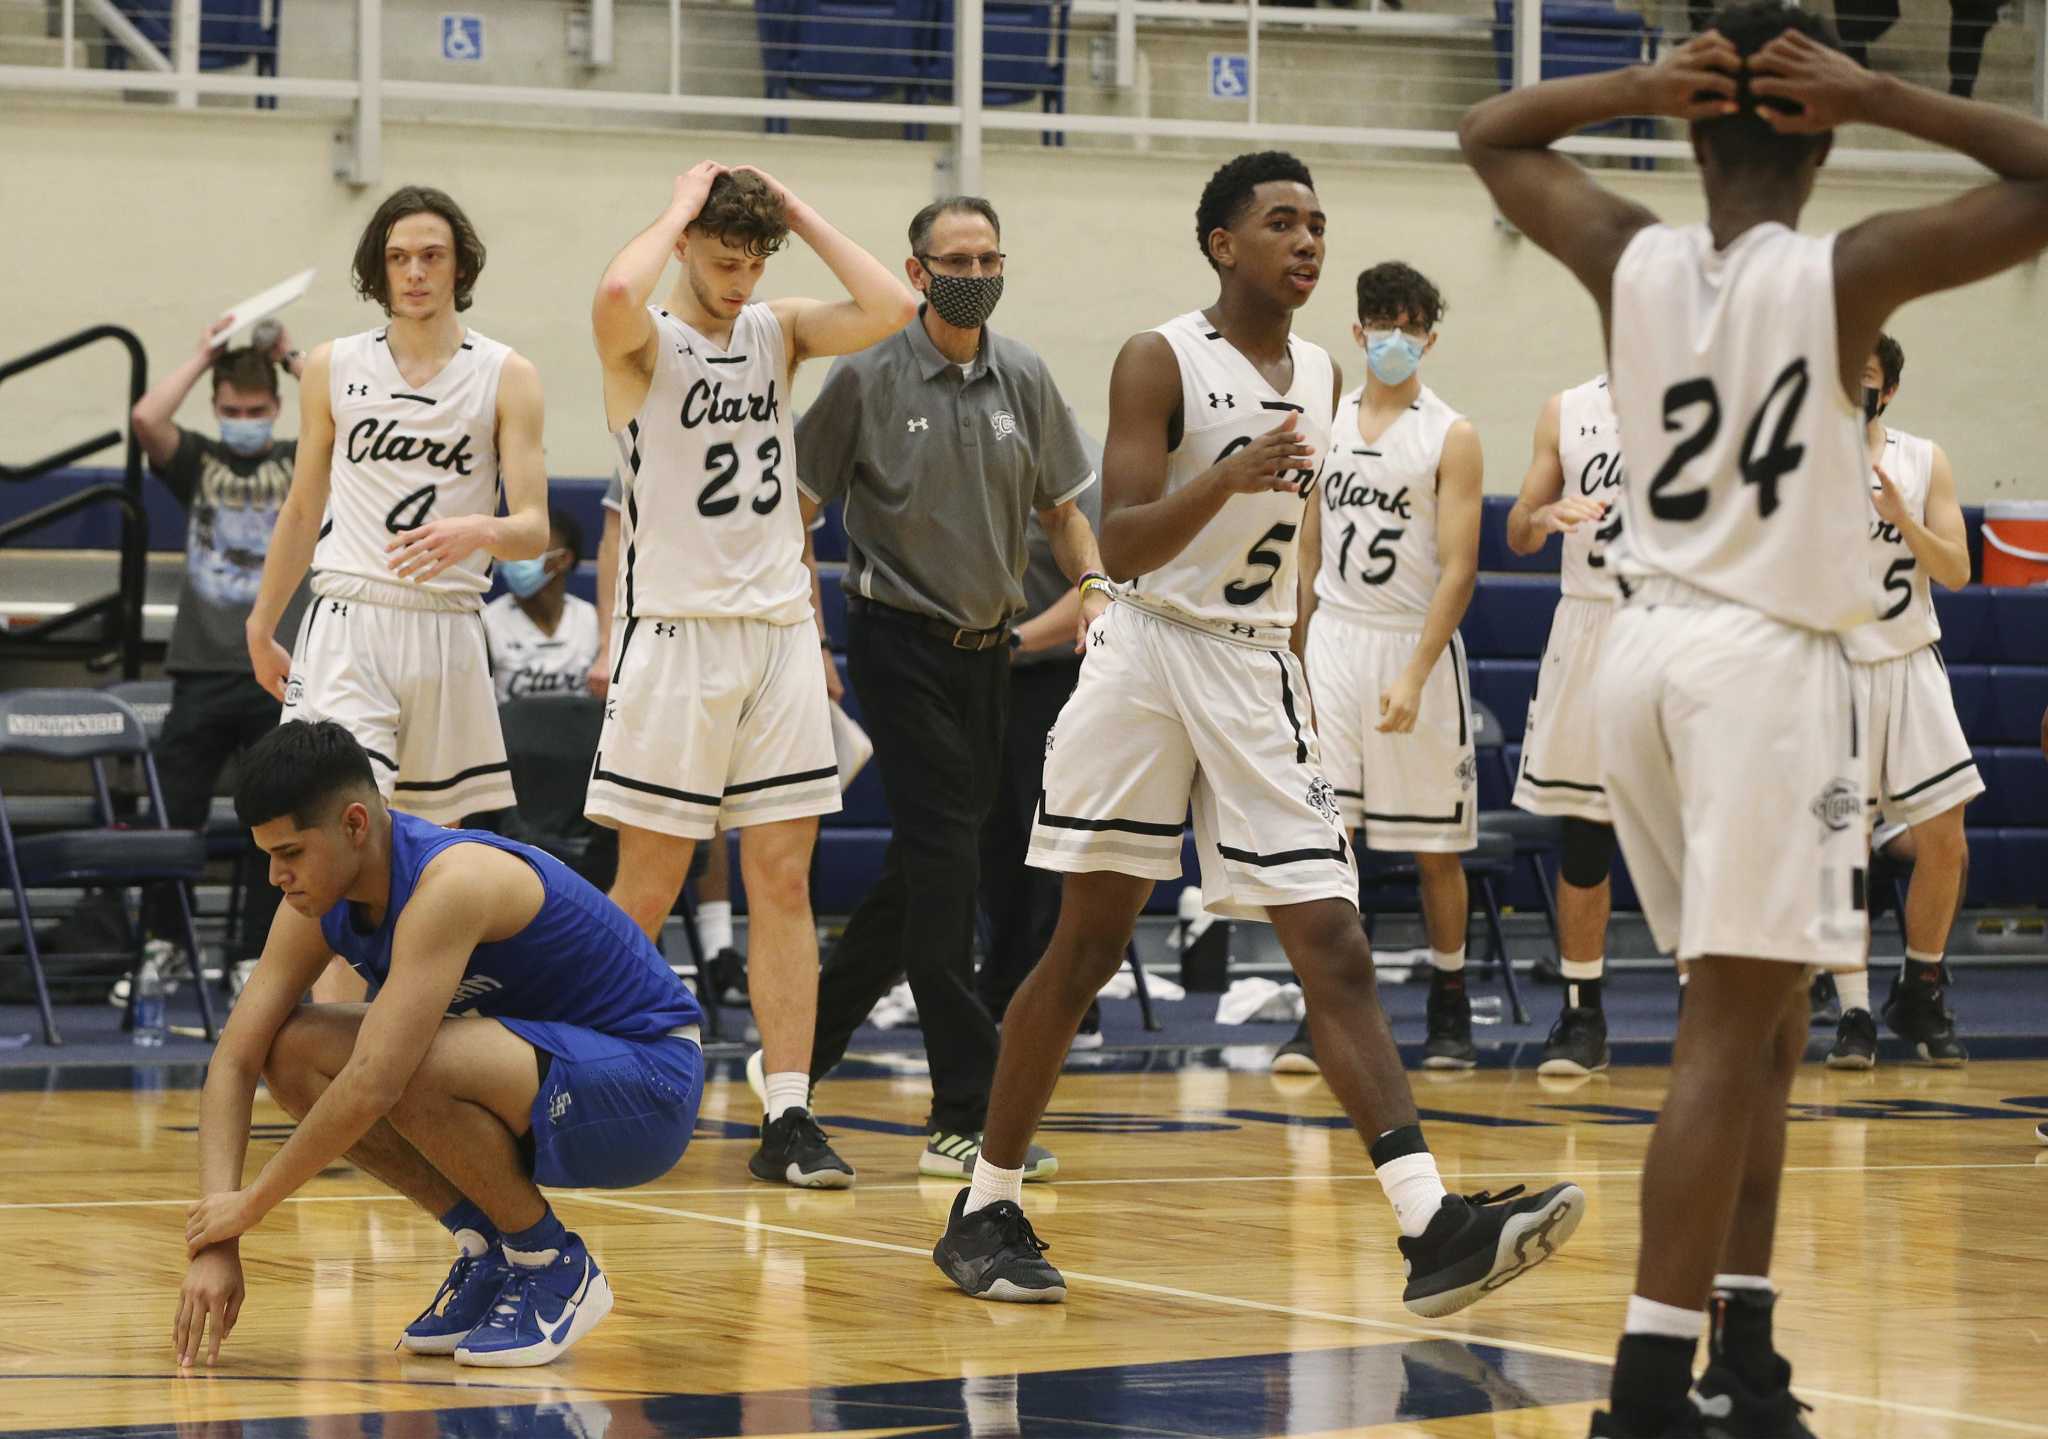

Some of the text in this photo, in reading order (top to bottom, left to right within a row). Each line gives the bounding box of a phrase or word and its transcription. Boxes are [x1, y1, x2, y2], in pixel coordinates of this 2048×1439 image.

[680, 378, 779, 429] Clark
[346, 418, 474, 475] Clark
[1649, 356, 1810, 521] 24
[697, 436, 782, 517] 23
[1325, 470, 1412, 519] Clark
[1224, 522, 1297, 606] 5
[1338, 520, 1405, 585] 15
